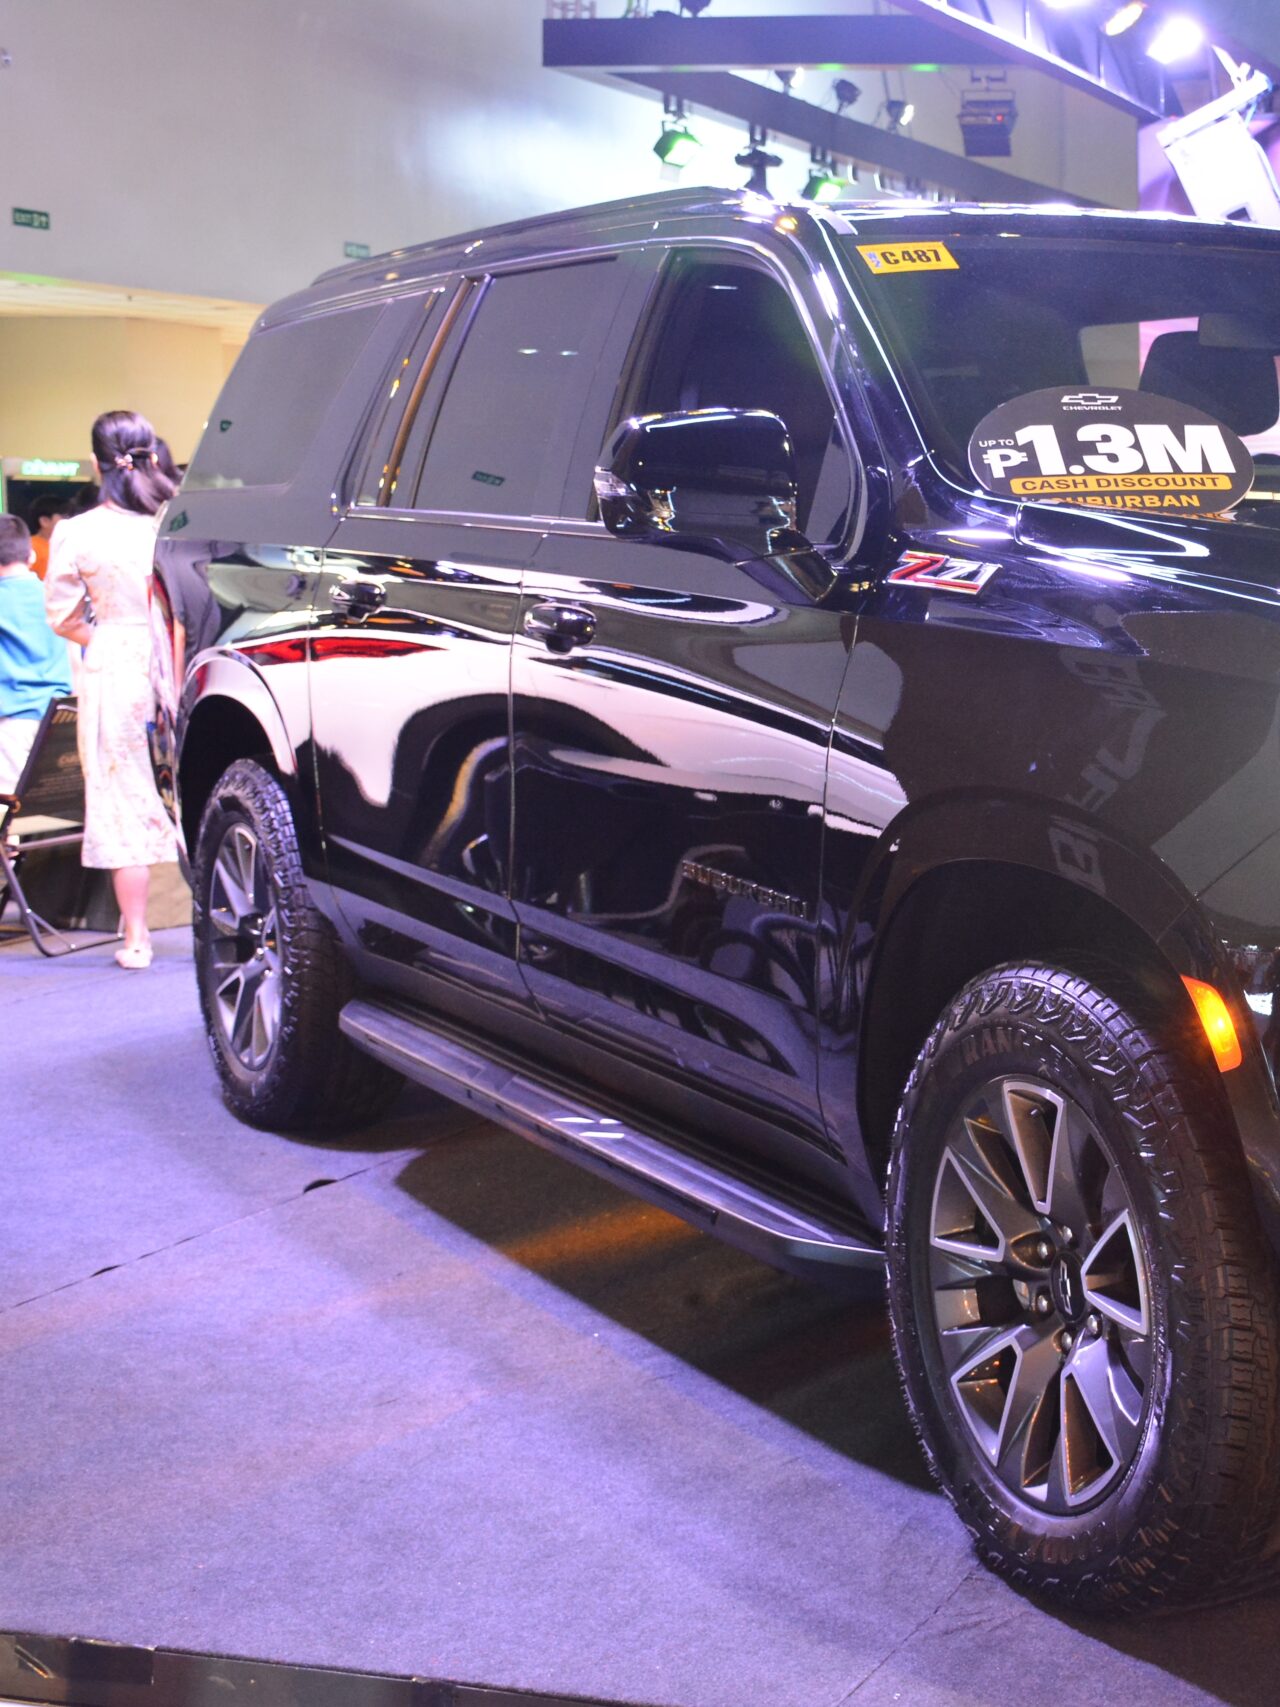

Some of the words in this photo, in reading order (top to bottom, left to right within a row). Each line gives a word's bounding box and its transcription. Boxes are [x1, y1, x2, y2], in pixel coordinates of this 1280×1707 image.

[880, 249, 942, 265] C487
[998, 438, 1015, 446] TO
[1021, 478, 1089, 491] CASH
[1096, 476, 1221, 489] DISCOUNT
[1050, 495, 1201, 507] BURBAN
[884, 550, 1003, 595] Z71
